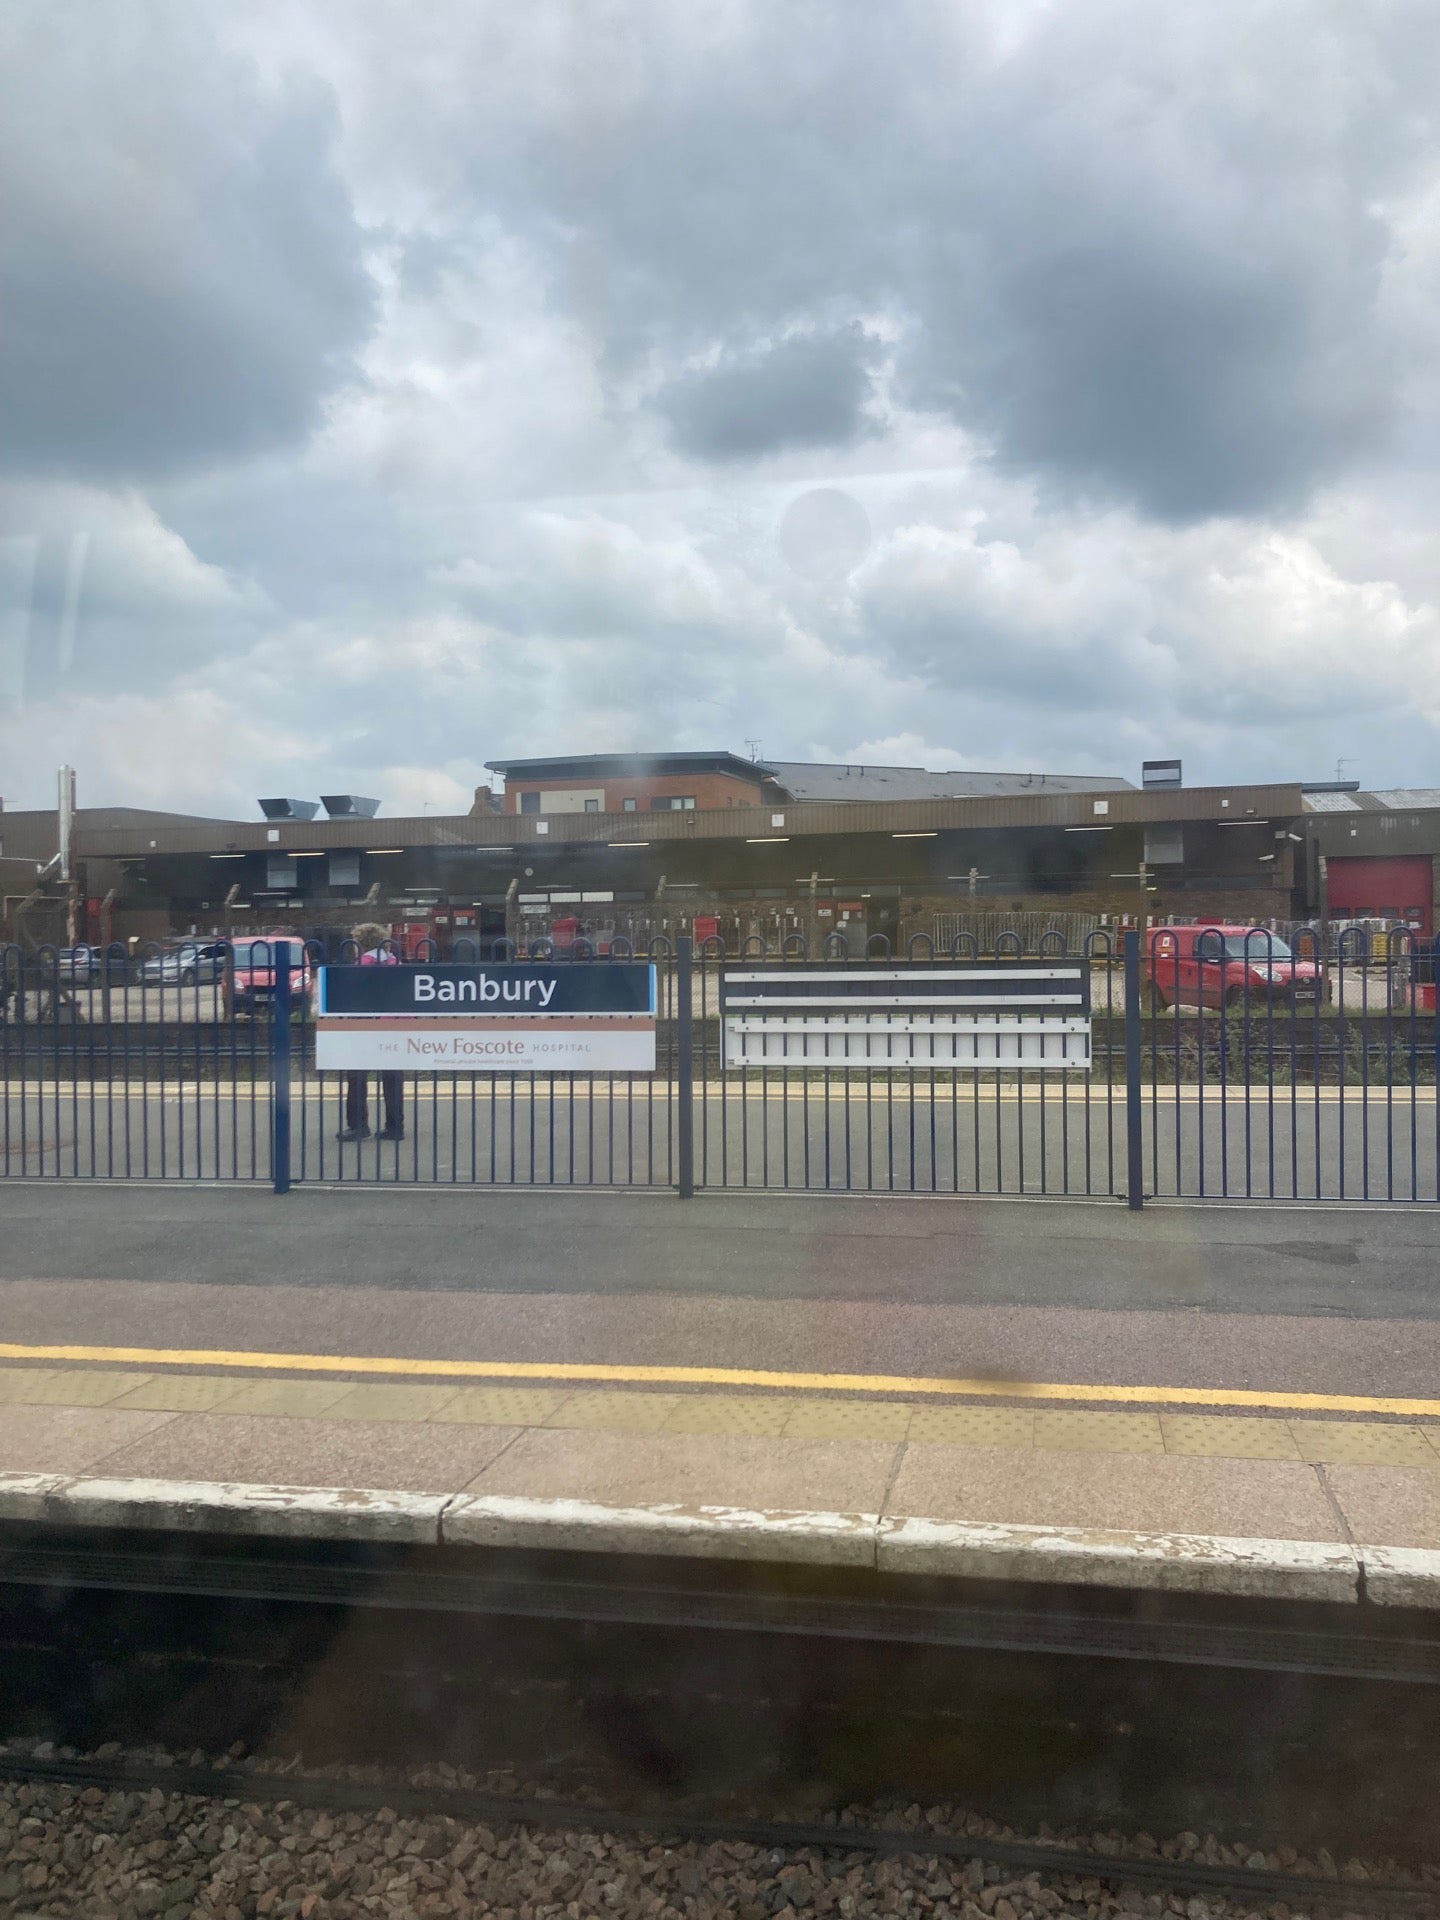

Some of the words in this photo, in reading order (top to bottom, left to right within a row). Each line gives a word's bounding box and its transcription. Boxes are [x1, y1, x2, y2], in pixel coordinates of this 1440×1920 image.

[414, 973, 557, 1006] Banbury
[378, 1043, 400, 1052] THE
[407, 1038, 448, 1054] New
[453, 1038, 525, 1054] Foscote
[533, 1043, 591, 1052] HOSPITAL
